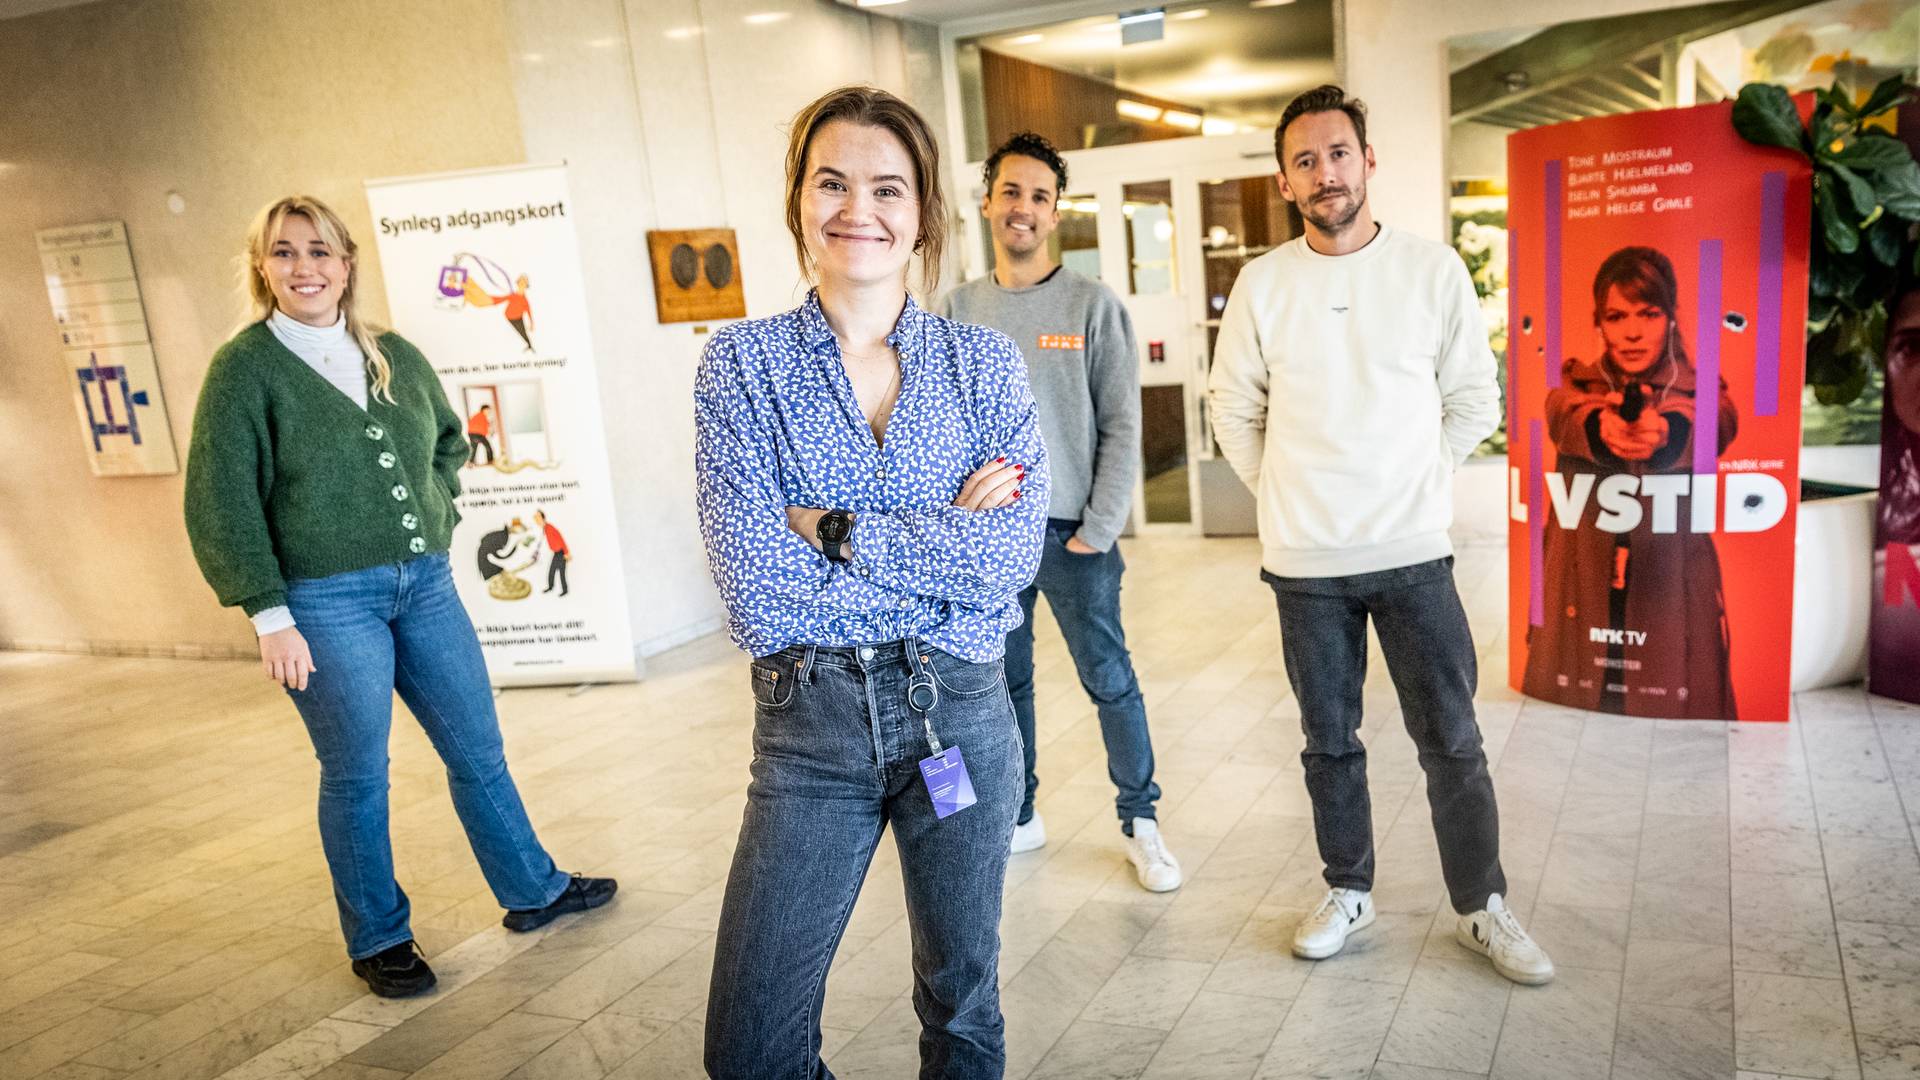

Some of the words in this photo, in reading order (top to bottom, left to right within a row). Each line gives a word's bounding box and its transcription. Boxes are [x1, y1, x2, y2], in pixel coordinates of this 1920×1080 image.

[1602, 147, 1673, 165] MOSTRAUM
[1613, 161, 1693, 181] HJELMELAND
[1606, 183, 1658, 200] SHUMBA
[1605, 201, 1646, 216] HELGE
[1652, 196, 1693, 213] GIMLE
[380, 214, 441, 237] Synleg
[447, 200, 565, 229] adgangskort
[1625, 630, 1647, 646] TV
